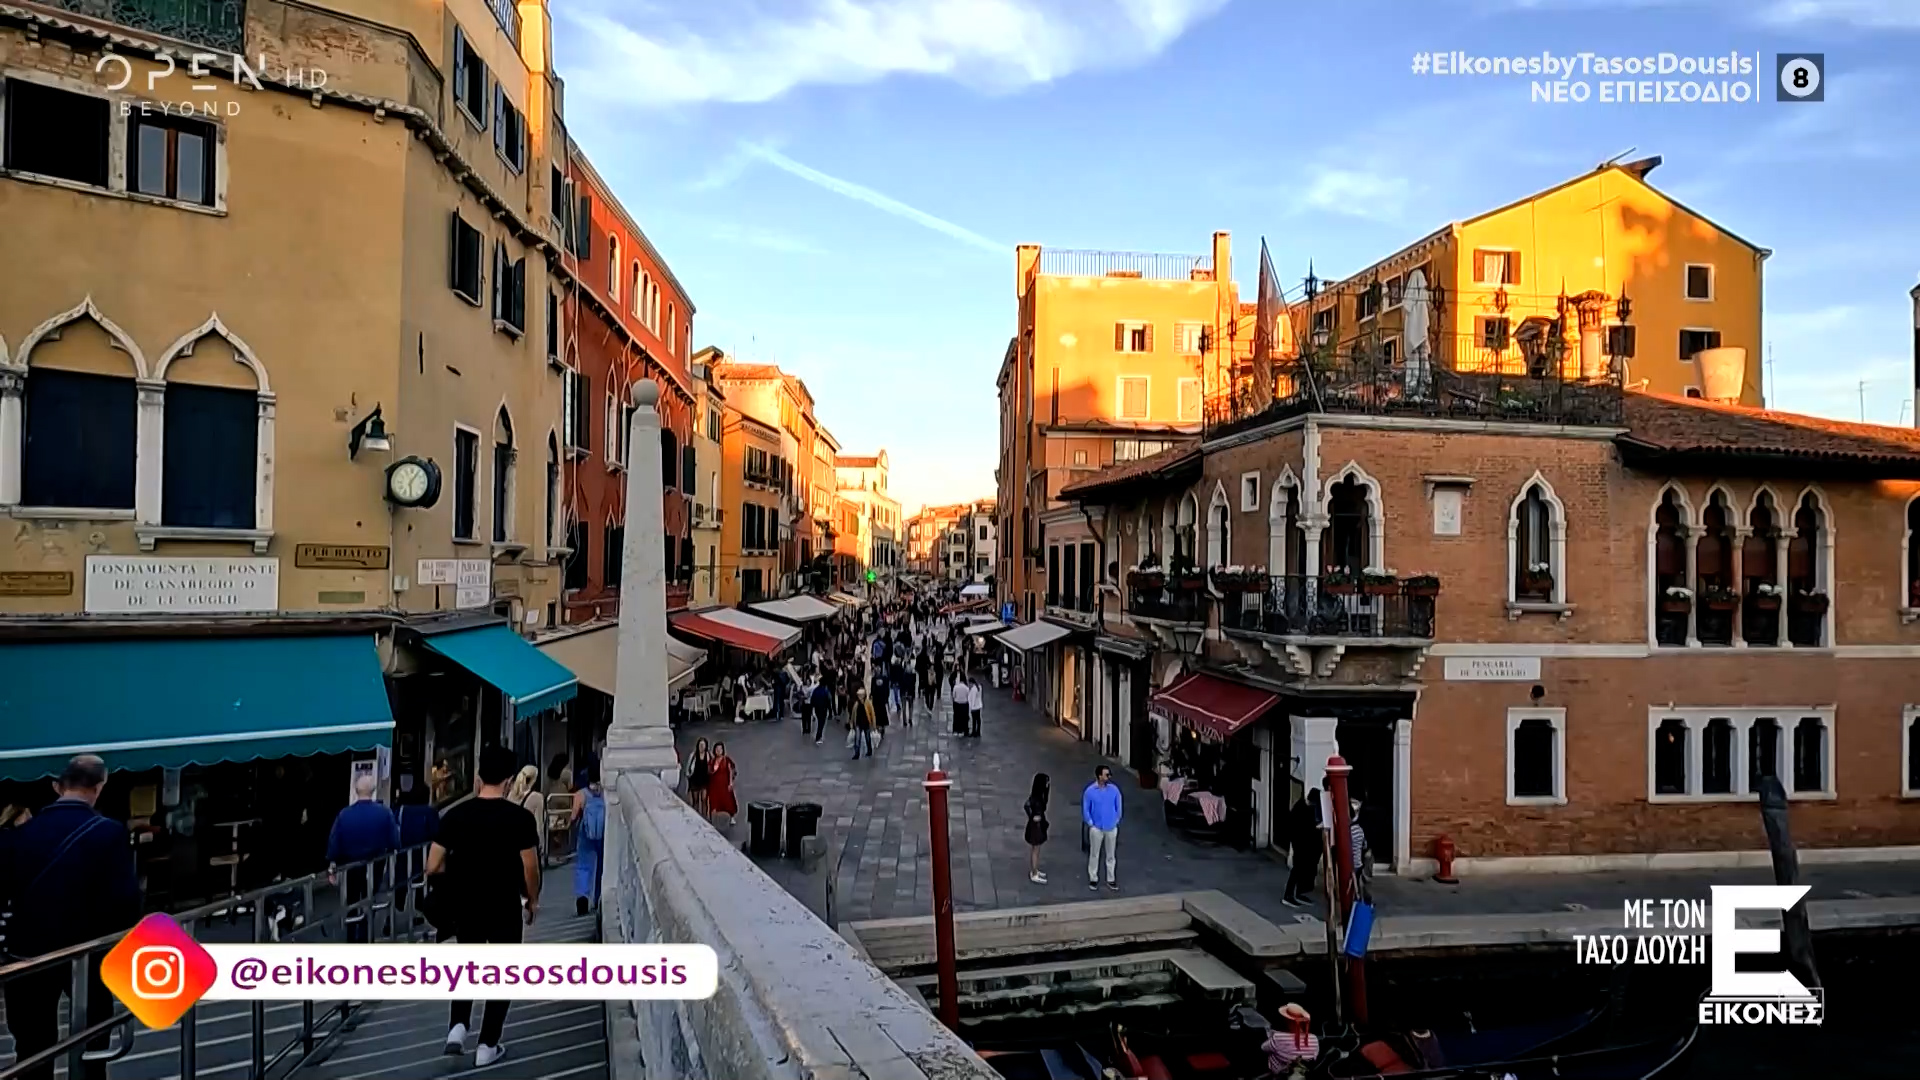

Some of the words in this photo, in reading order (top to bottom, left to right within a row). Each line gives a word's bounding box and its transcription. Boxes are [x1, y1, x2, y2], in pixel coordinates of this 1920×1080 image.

[92, 563, 197, 575] FONDAMENTA
[228, 564, 276, 575] PONTE
[114, 579, 135, 591] DE
[144, 579, 234, 591] CANAREGIO
[244, 580, 255, 590] O
